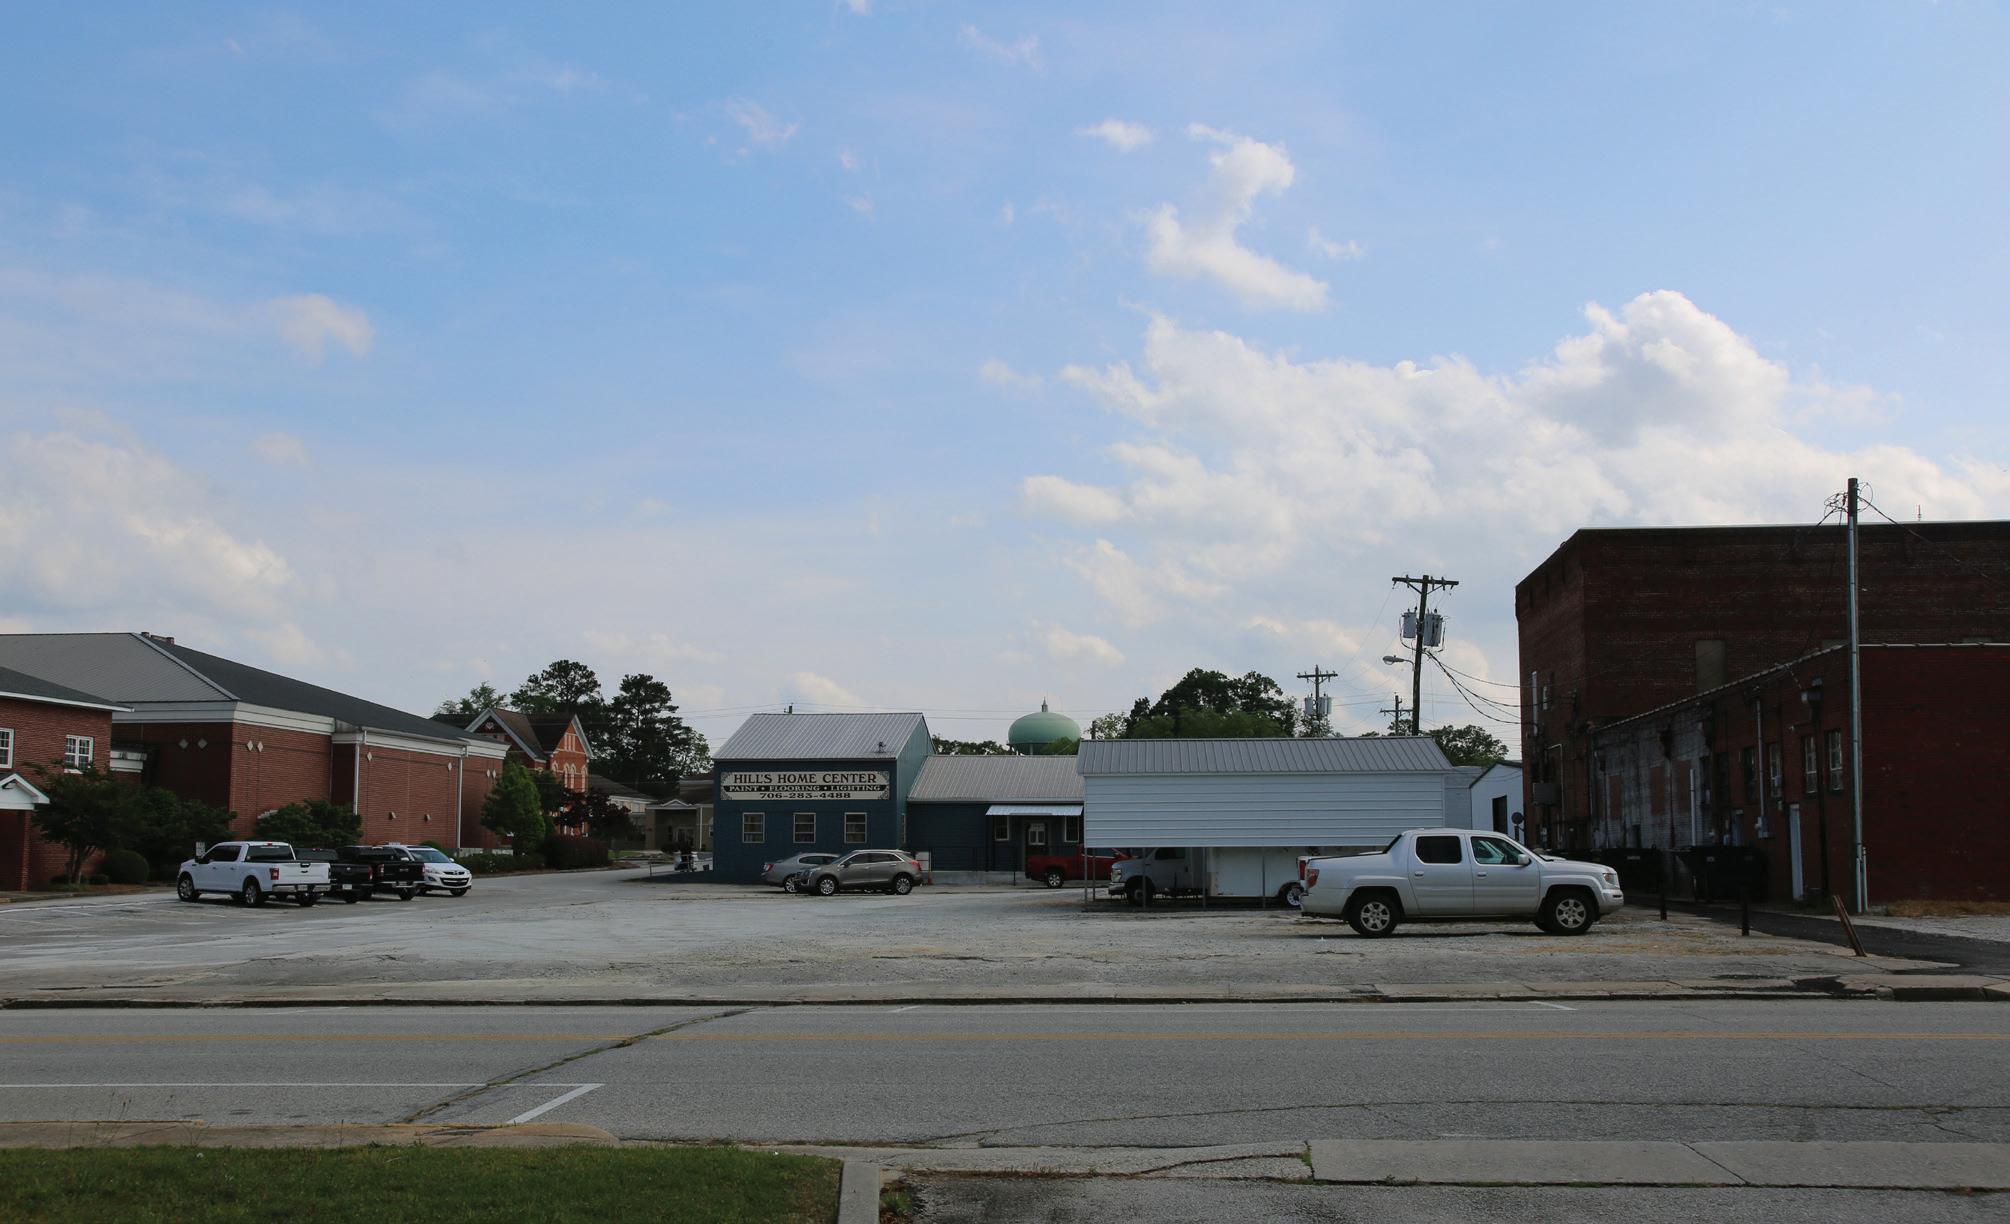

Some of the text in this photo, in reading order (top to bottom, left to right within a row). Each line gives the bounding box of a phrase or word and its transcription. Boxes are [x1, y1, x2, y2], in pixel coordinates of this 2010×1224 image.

[733, 773, 877, 784] HILL'S HOME CENTER
